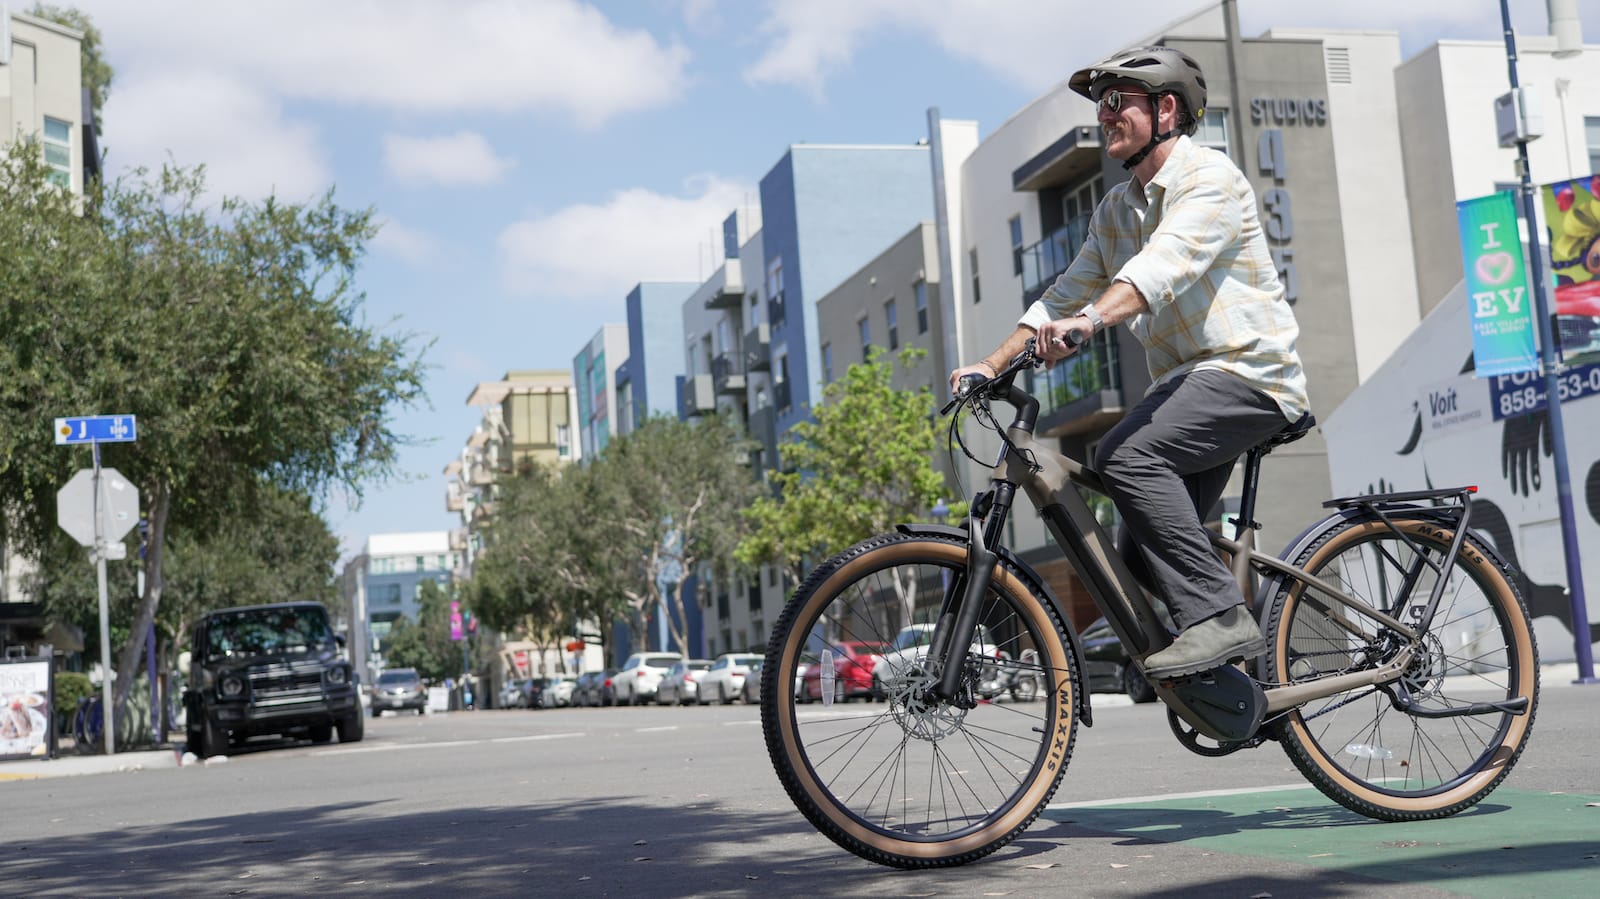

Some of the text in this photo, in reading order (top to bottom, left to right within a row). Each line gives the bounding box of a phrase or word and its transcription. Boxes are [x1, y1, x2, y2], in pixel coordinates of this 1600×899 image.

[1250, 97, 1326, 122] STUDIOS
[1480, 223, 1501, 249] I
[1472, 287, 1525, 318] EV
[1429, 387, 1457, 416] Voit
[1500, 367, 1600, 415] 858-53-0
[79, 421, 87, 439] J
[1047, 689, 1069, 771] MAXXIS
